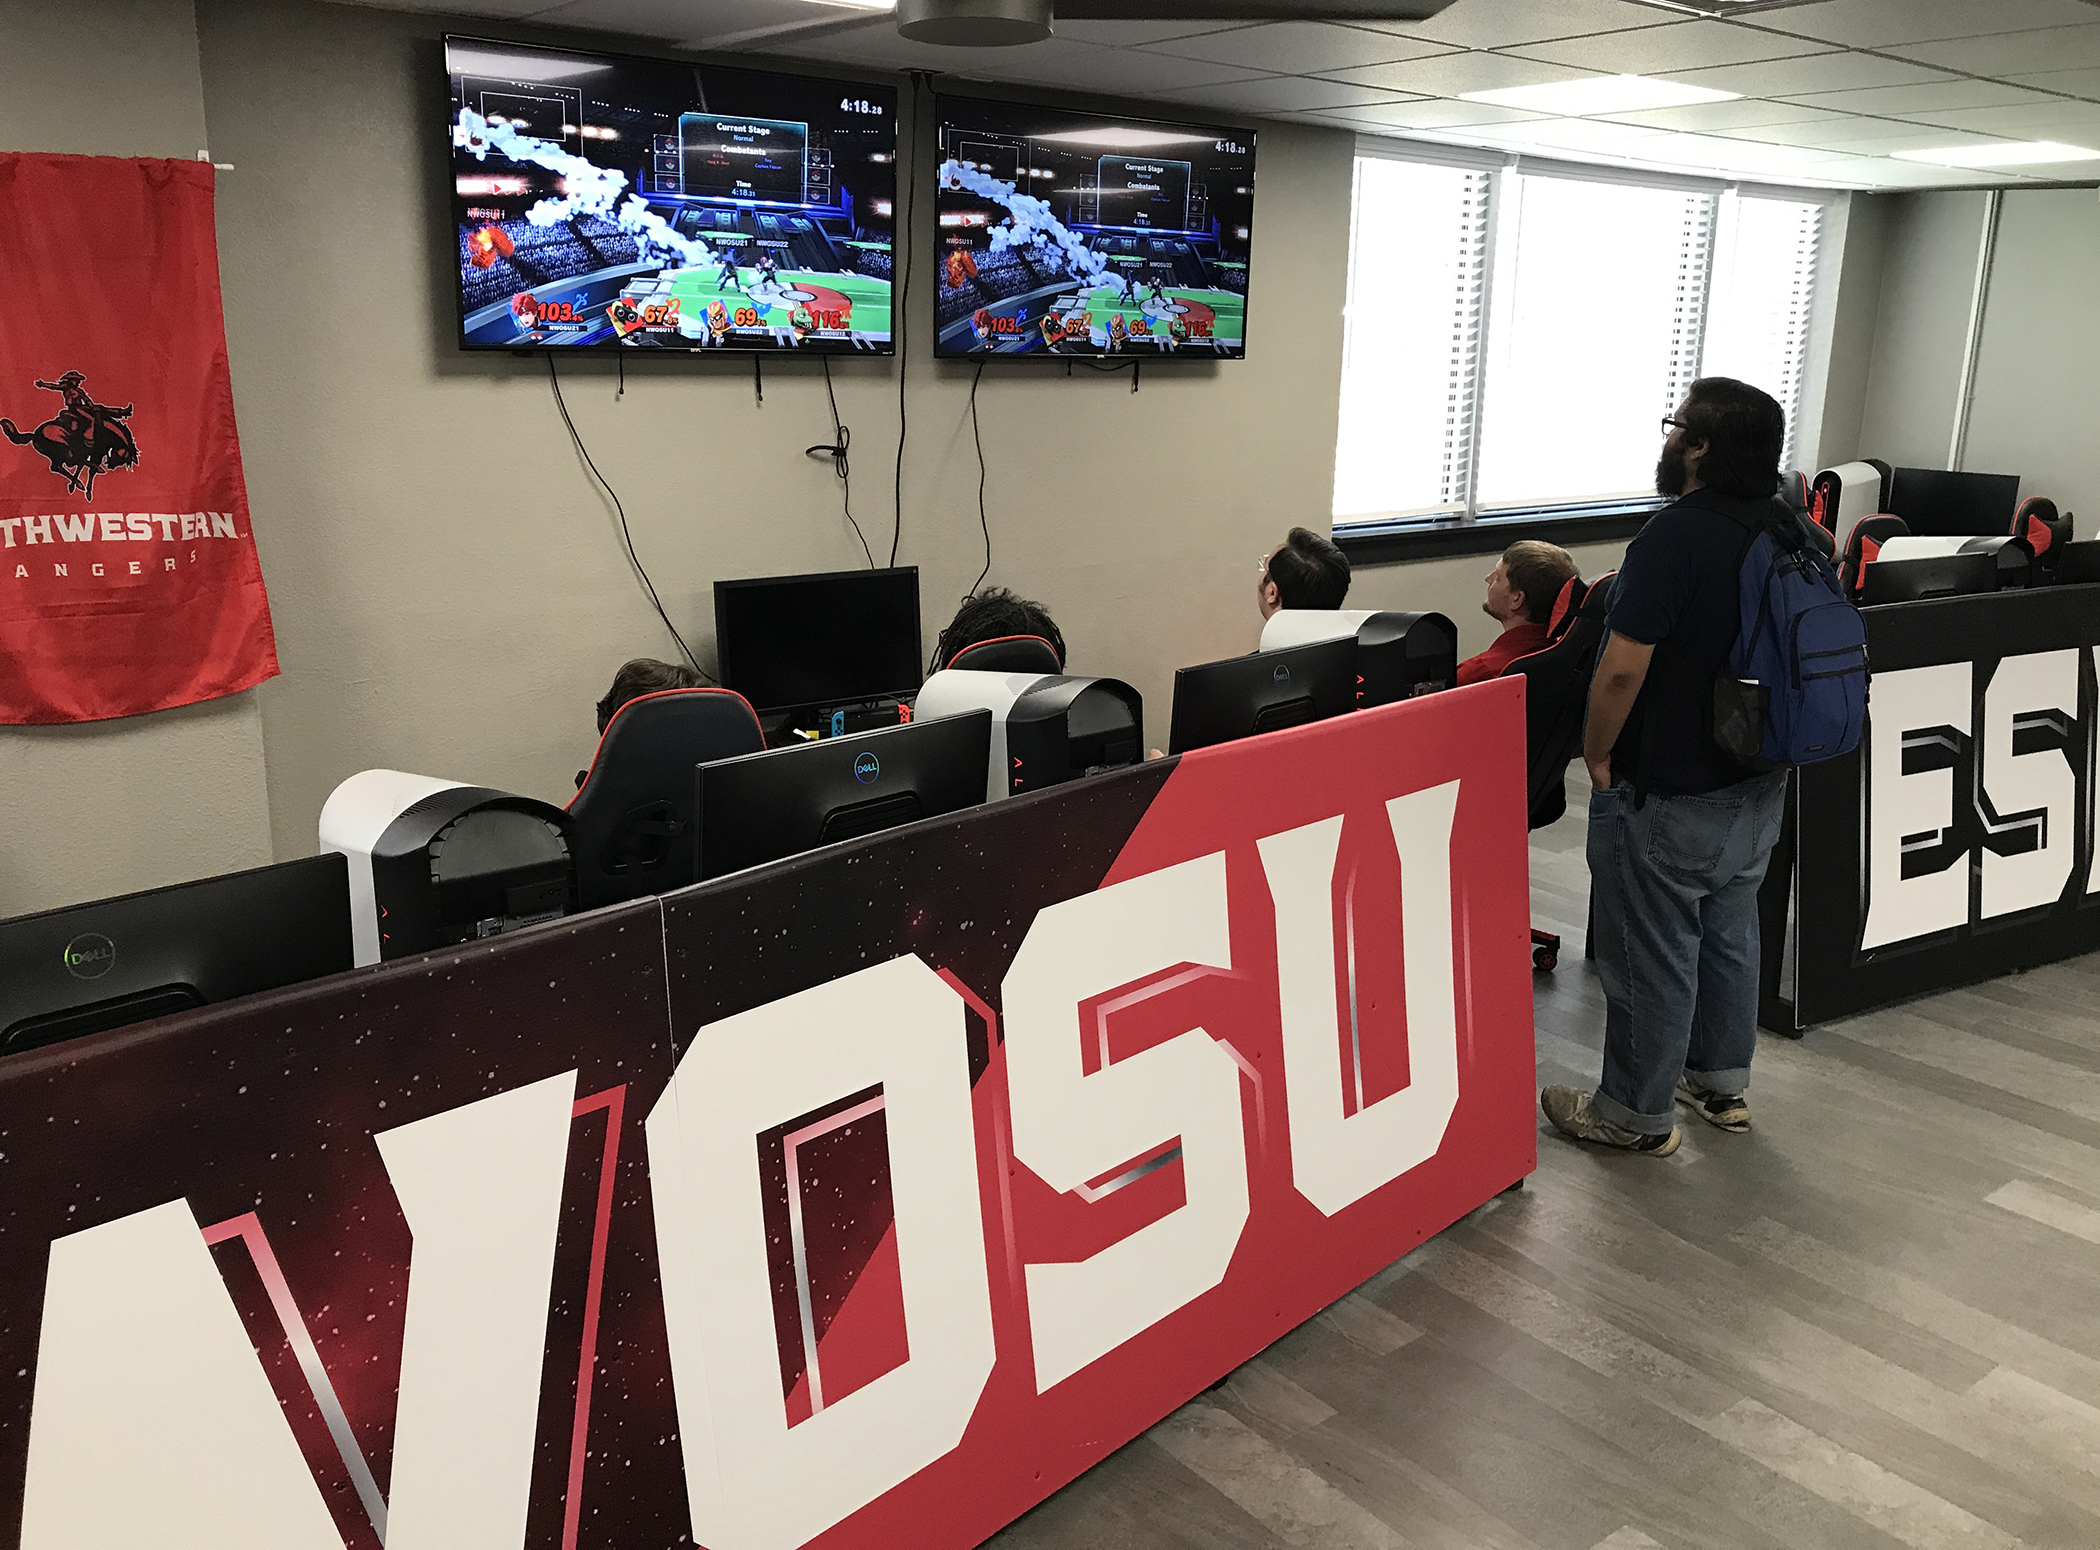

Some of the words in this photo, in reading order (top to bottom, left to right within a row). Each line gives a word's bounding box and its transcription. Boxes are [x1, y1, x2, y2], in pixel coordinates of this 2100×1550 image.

[840, 98, 883, 115] 4:18.28
[716, 122, 747, 133] Current
[748, 125, 771, 136] Stage
[733, 134, 754, 142] Normal
[721, 144, 766, 156] Combatants
[1125, 163, 1146, 171] Current
[1148, 165, 1164, 174] Stage
[735, 180, 752, 188] Time
[715, 238, 748, 247] NWOSU21
[0, 511, 240, 548] THWESTERN
[1861, 645, 2100, 951] ES
